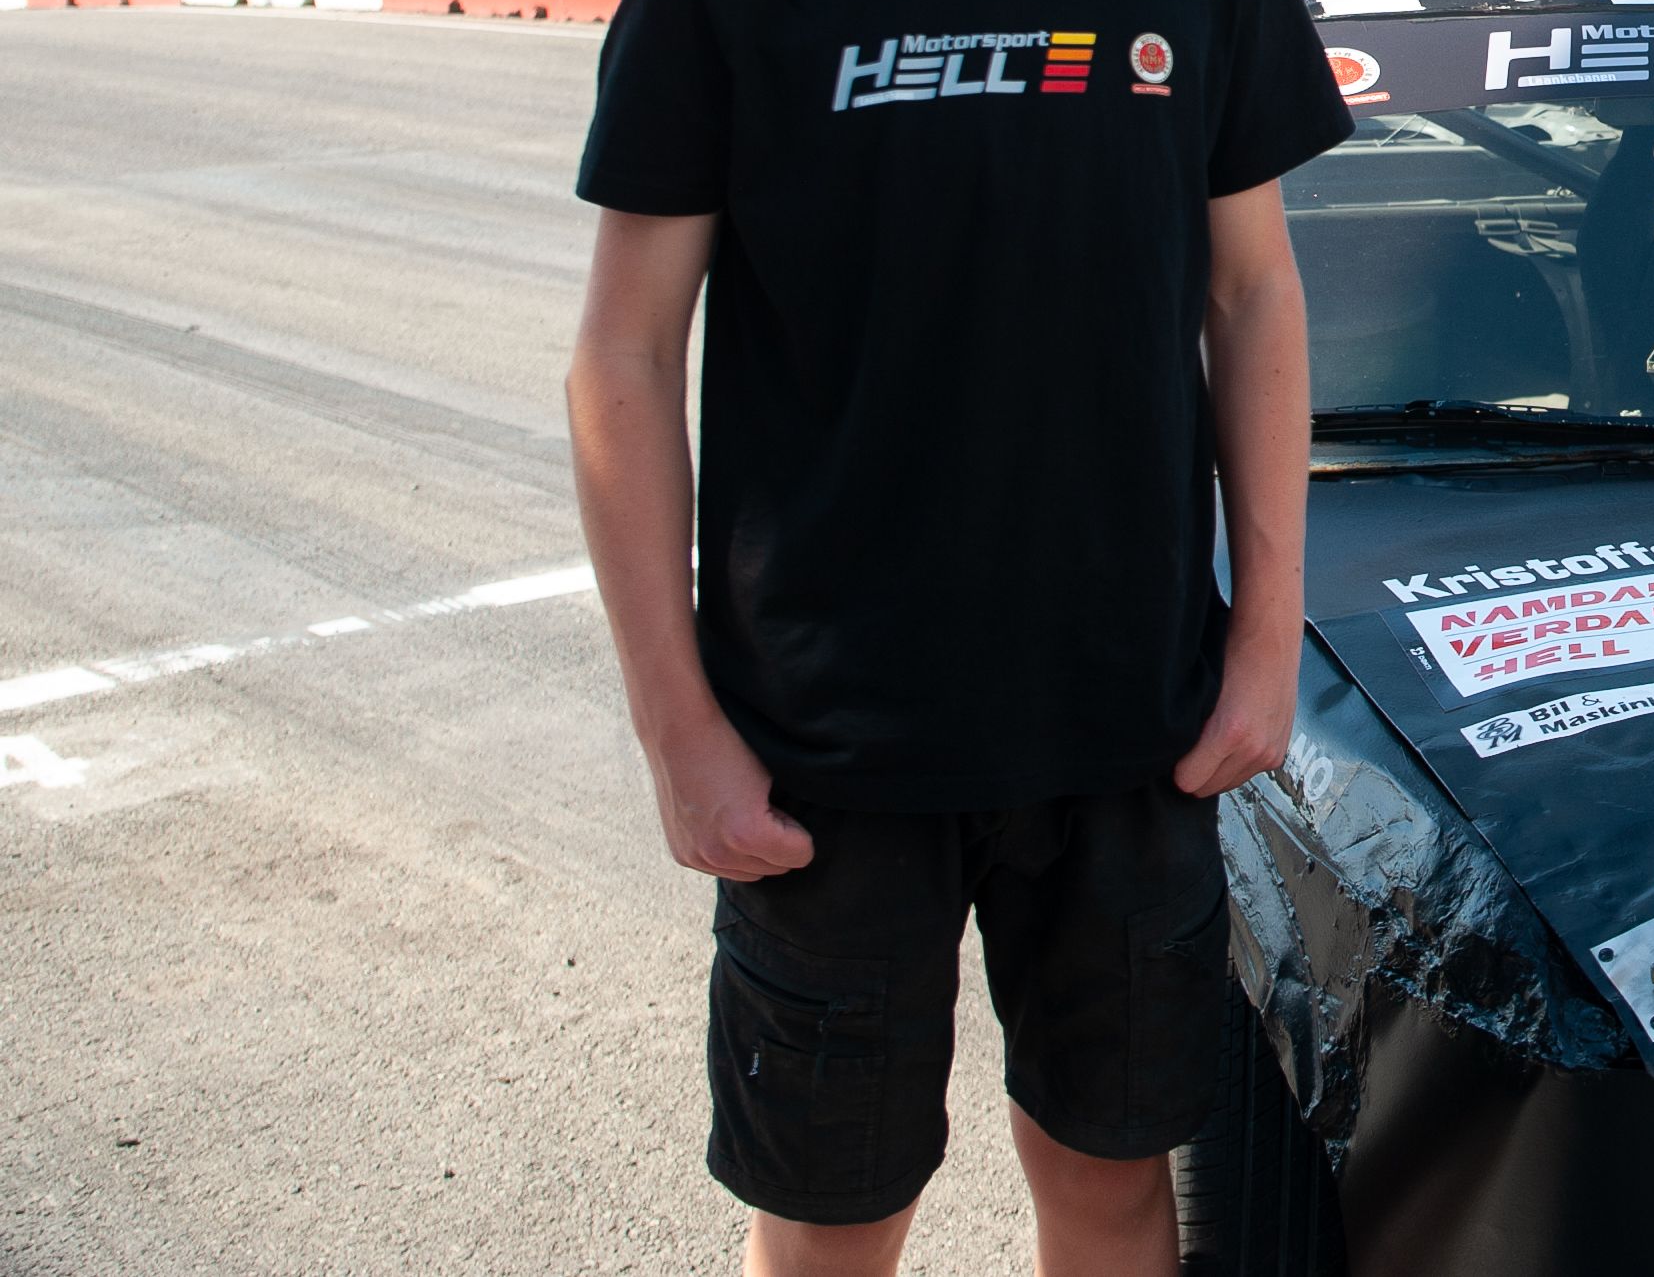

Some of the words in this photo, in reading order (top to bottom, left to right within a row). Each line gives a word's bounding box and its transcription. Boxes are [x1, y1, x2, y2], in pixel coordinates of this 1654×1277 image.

[902, 30, 1050, 53] Motorsport
[832, 39, 1027, 111] HELL
[1473, 639, 1630, 682] HELL
[1528, 701, 1570, 722] Bil
[1582, 694, 1602, 706] &
